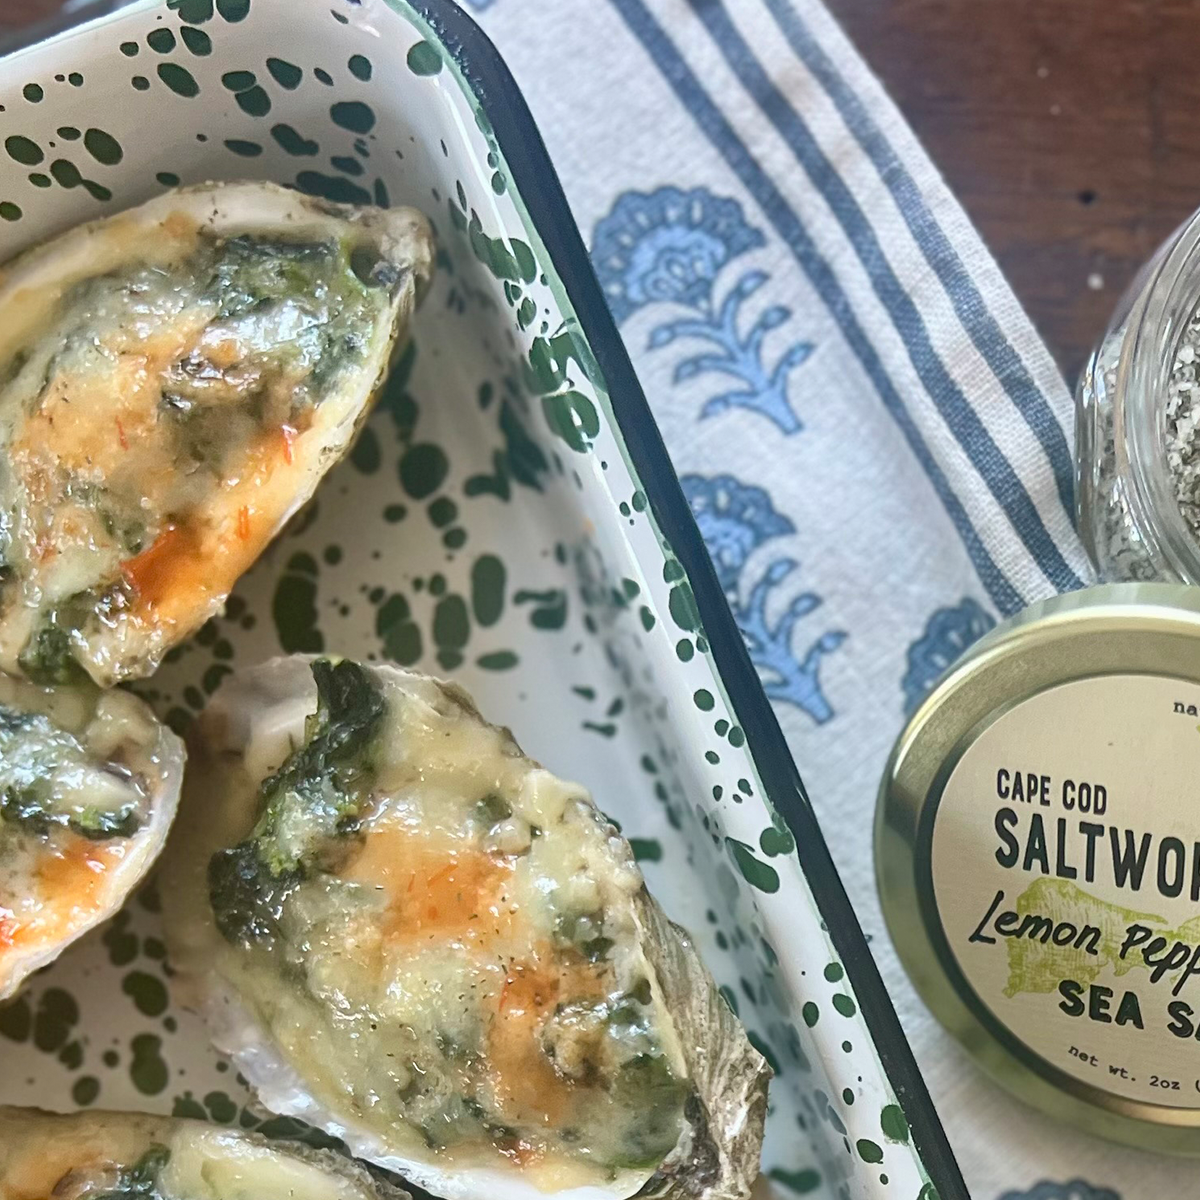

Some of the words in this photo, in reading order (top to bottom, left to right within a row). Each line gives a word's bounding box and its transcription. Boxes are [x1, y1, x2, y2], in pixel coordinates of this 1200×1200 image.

[997, 769, 1051, 806] CAPE
[1062, 780, 1107, 815] COD
[968, 890, 1101, 956] Lemon
[1058, 980, 1144, 1030] SEA
[1068, 1045, 1099, 1068] net
[1108, 1066, 1136, 1082] wt.
[1149, 1075, 1181, 1091] 2oz
